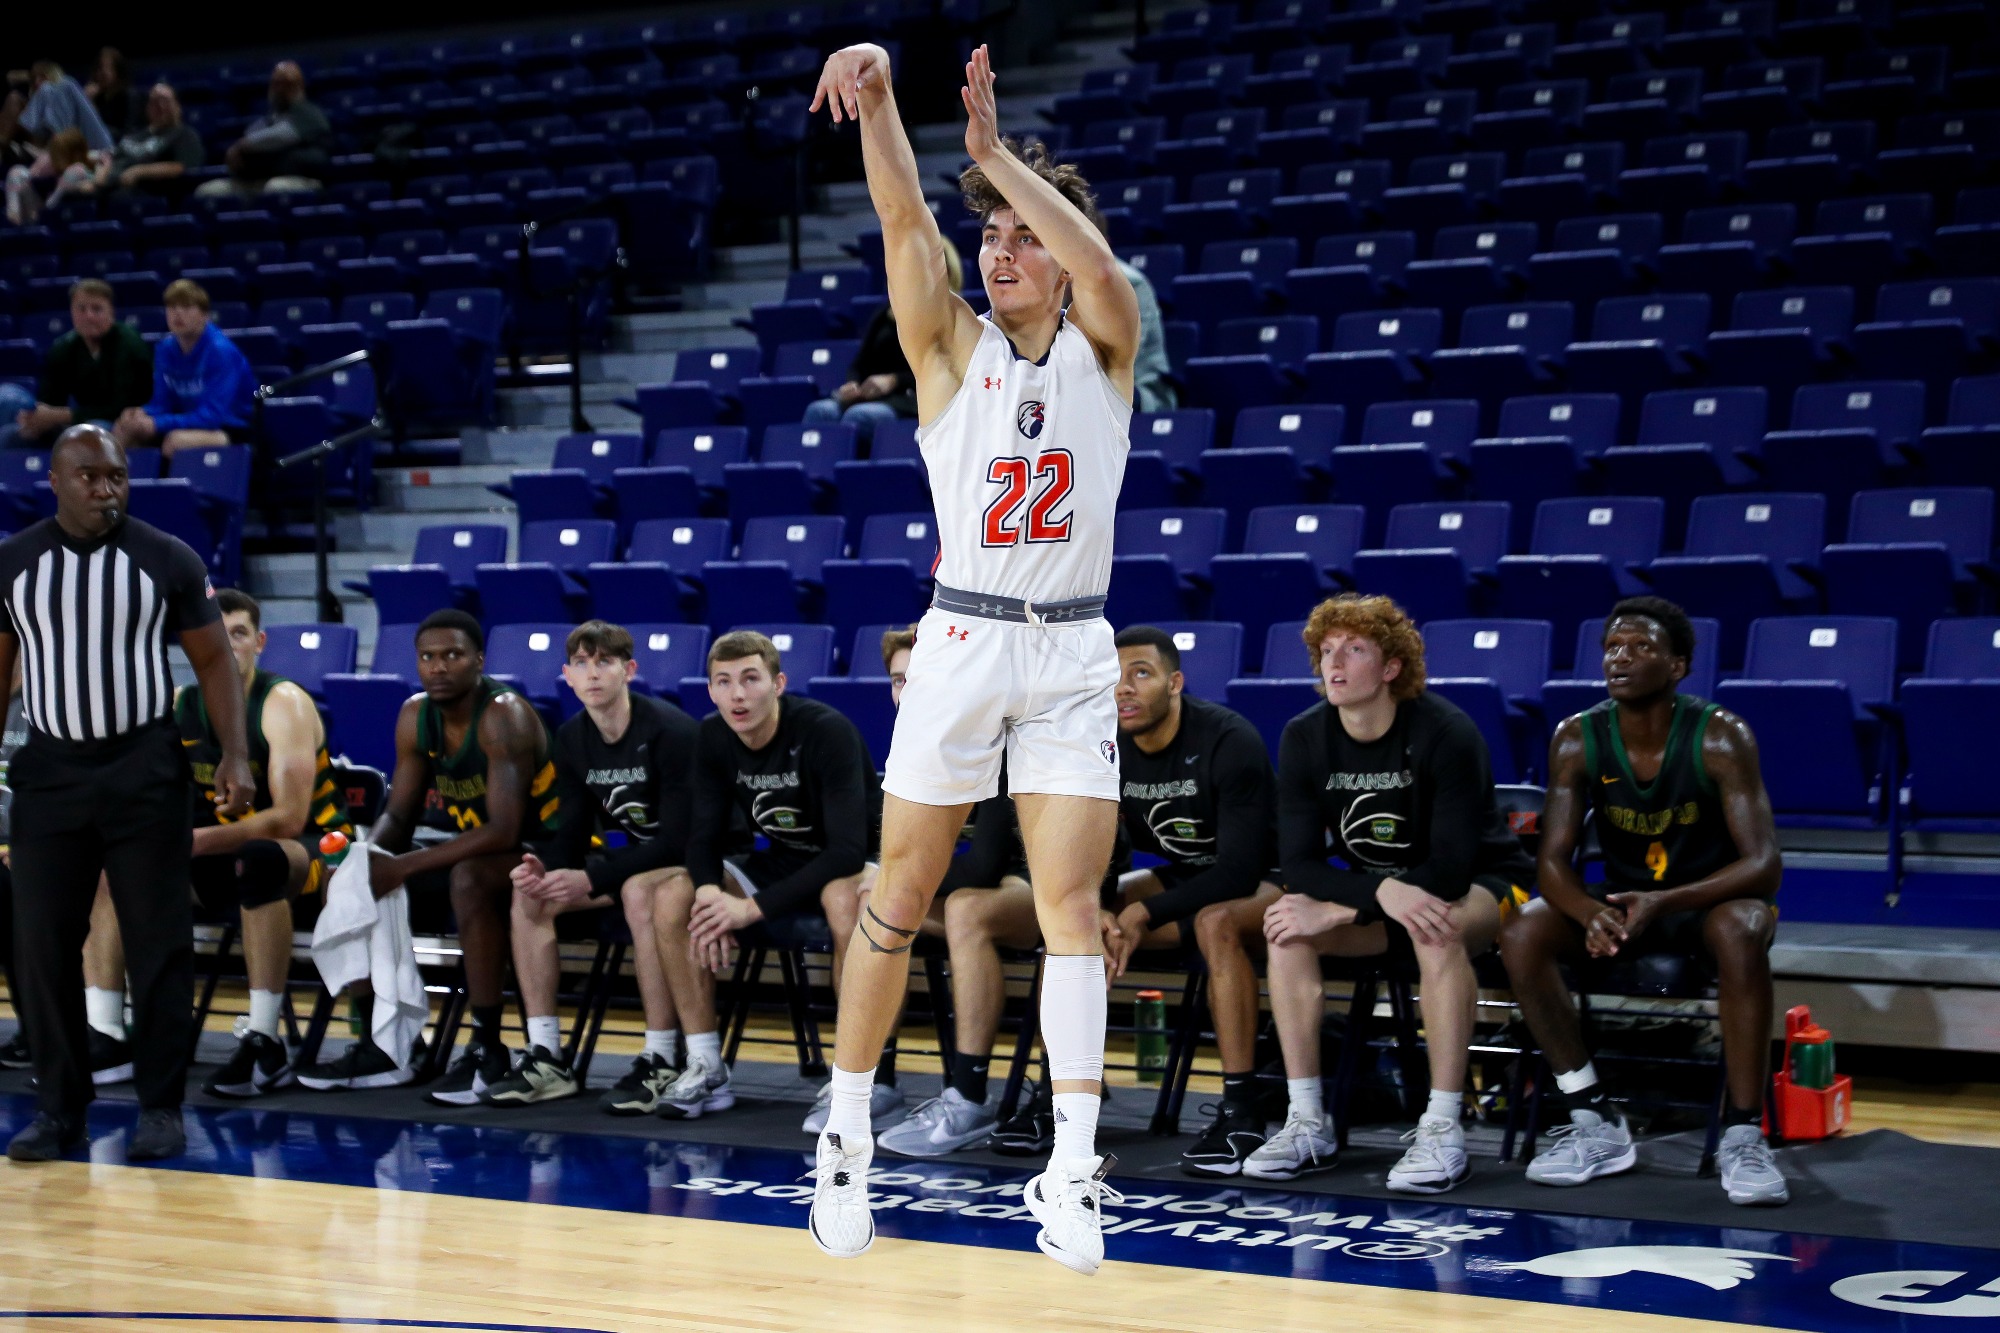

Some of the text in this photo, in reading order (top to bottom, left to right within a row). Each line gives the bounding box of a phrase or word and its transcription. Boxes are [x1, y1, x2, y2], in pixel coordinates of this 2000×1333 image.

[981, 448, 1074, 548] 22
[1122, 779, 1199, 800] ARKANSS
[1325, 768, 1413, 790] ARKANSAS
